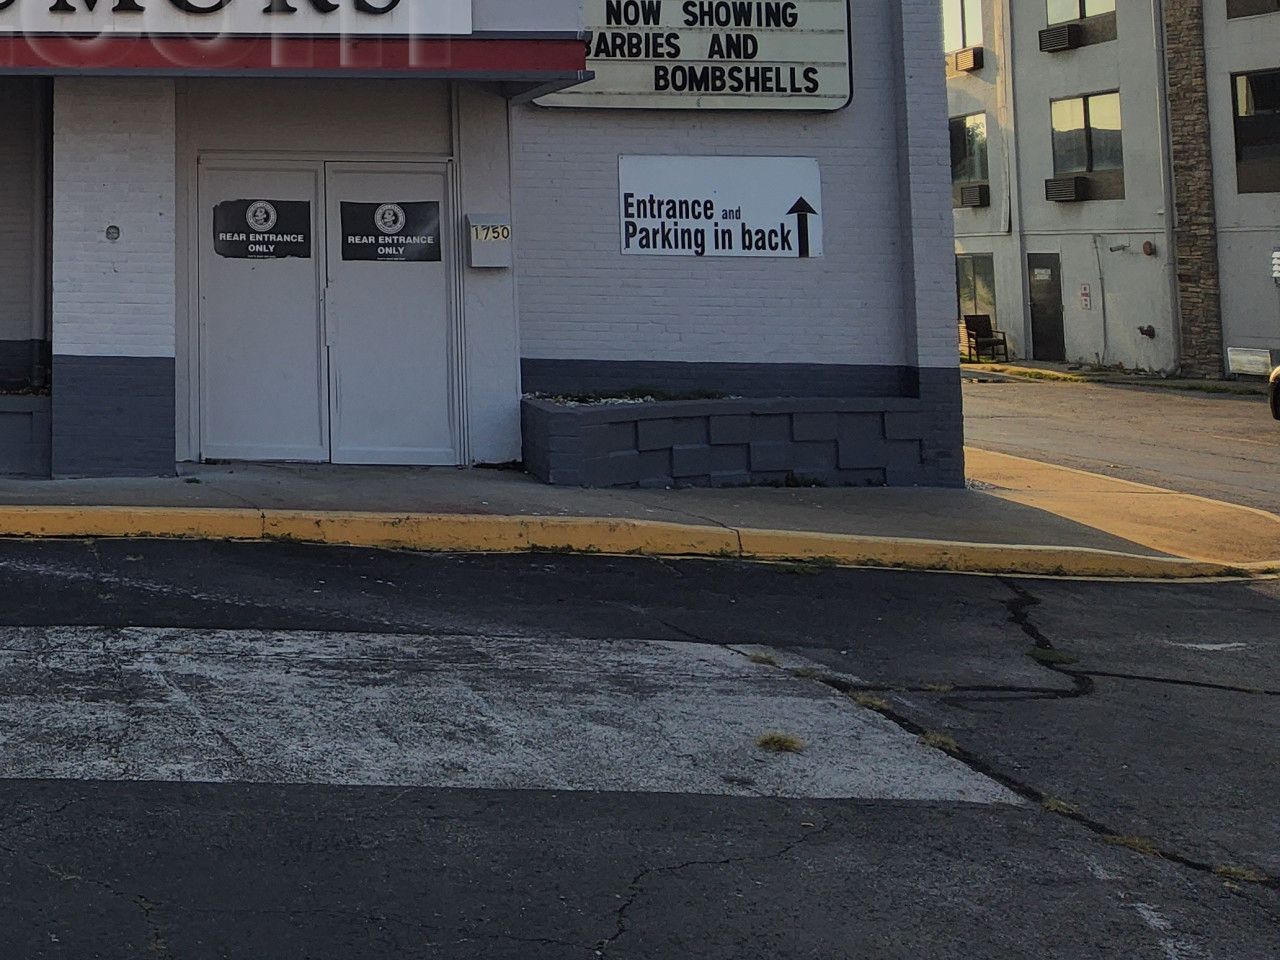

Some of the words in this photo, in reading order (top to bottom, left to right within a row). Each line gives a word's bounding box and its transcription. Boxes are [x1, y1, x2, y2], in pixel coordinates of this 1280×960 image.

[606, 0, 661, 25] NOW
[683, 1, 798, 27] SHOWING
[708, 34, 758, 59] AND
[654, 66, 819, 93] BOMBSHELLS
[624, 193, 714, 220] Entrance
[721, 206, 741, 220] and
[219, 233, 247, 242] REAR
[249, 233, 304, 243] ENTRANCE
[347, 236, 376, 244] REAR
[378, 236, 434, 244] ENTRANCE
[472, 225, 510, 240] 1750
[624, 221, 705, 256] Parking
[714, 222, 733, 250] in
[741, 223, 792, 251] back
[248, 244, 275, 253] ONLY
[377, 246, 405, 255] ONLY
